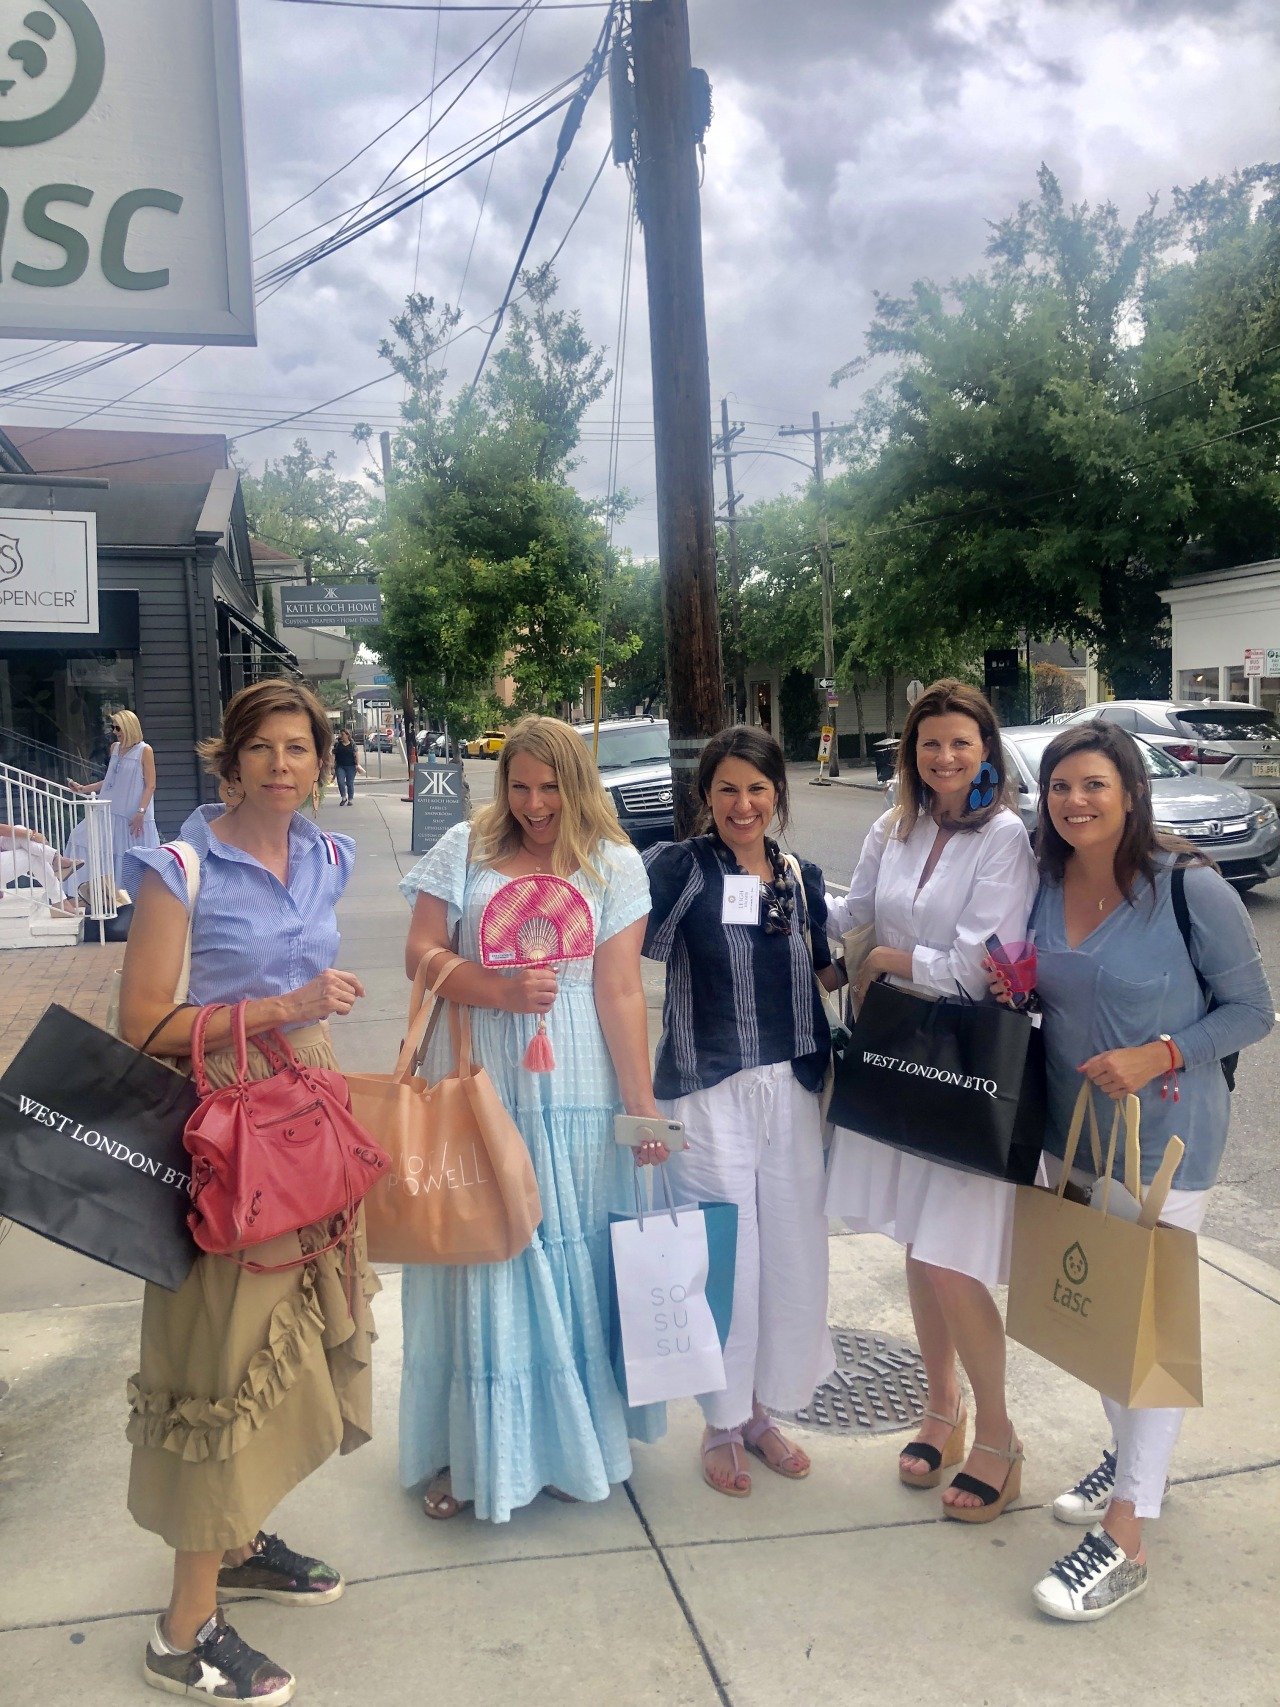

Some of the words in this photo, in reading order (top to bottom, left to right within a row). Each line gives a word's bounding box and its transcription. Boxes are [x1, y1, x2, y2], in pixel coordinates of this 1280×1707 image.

[0, 184, 183, 290] sc
[0, 590, 75, 607] PENCER
[286, 604, 314, 613] KATIE
[316, 603, 345, 612] KOCH
[348, 602, 377, 612] HOME
[862, 1051, 899, 1069] WEST
[898, 1060, 962, 1086] LONDON
[964, 1075, 998, 1098] BTQ
[18, 1094, 73, 1132] WEST
[71, 1123, 163, 1177] LONDON
[1052, 1278, 1093, 1318] tasc
